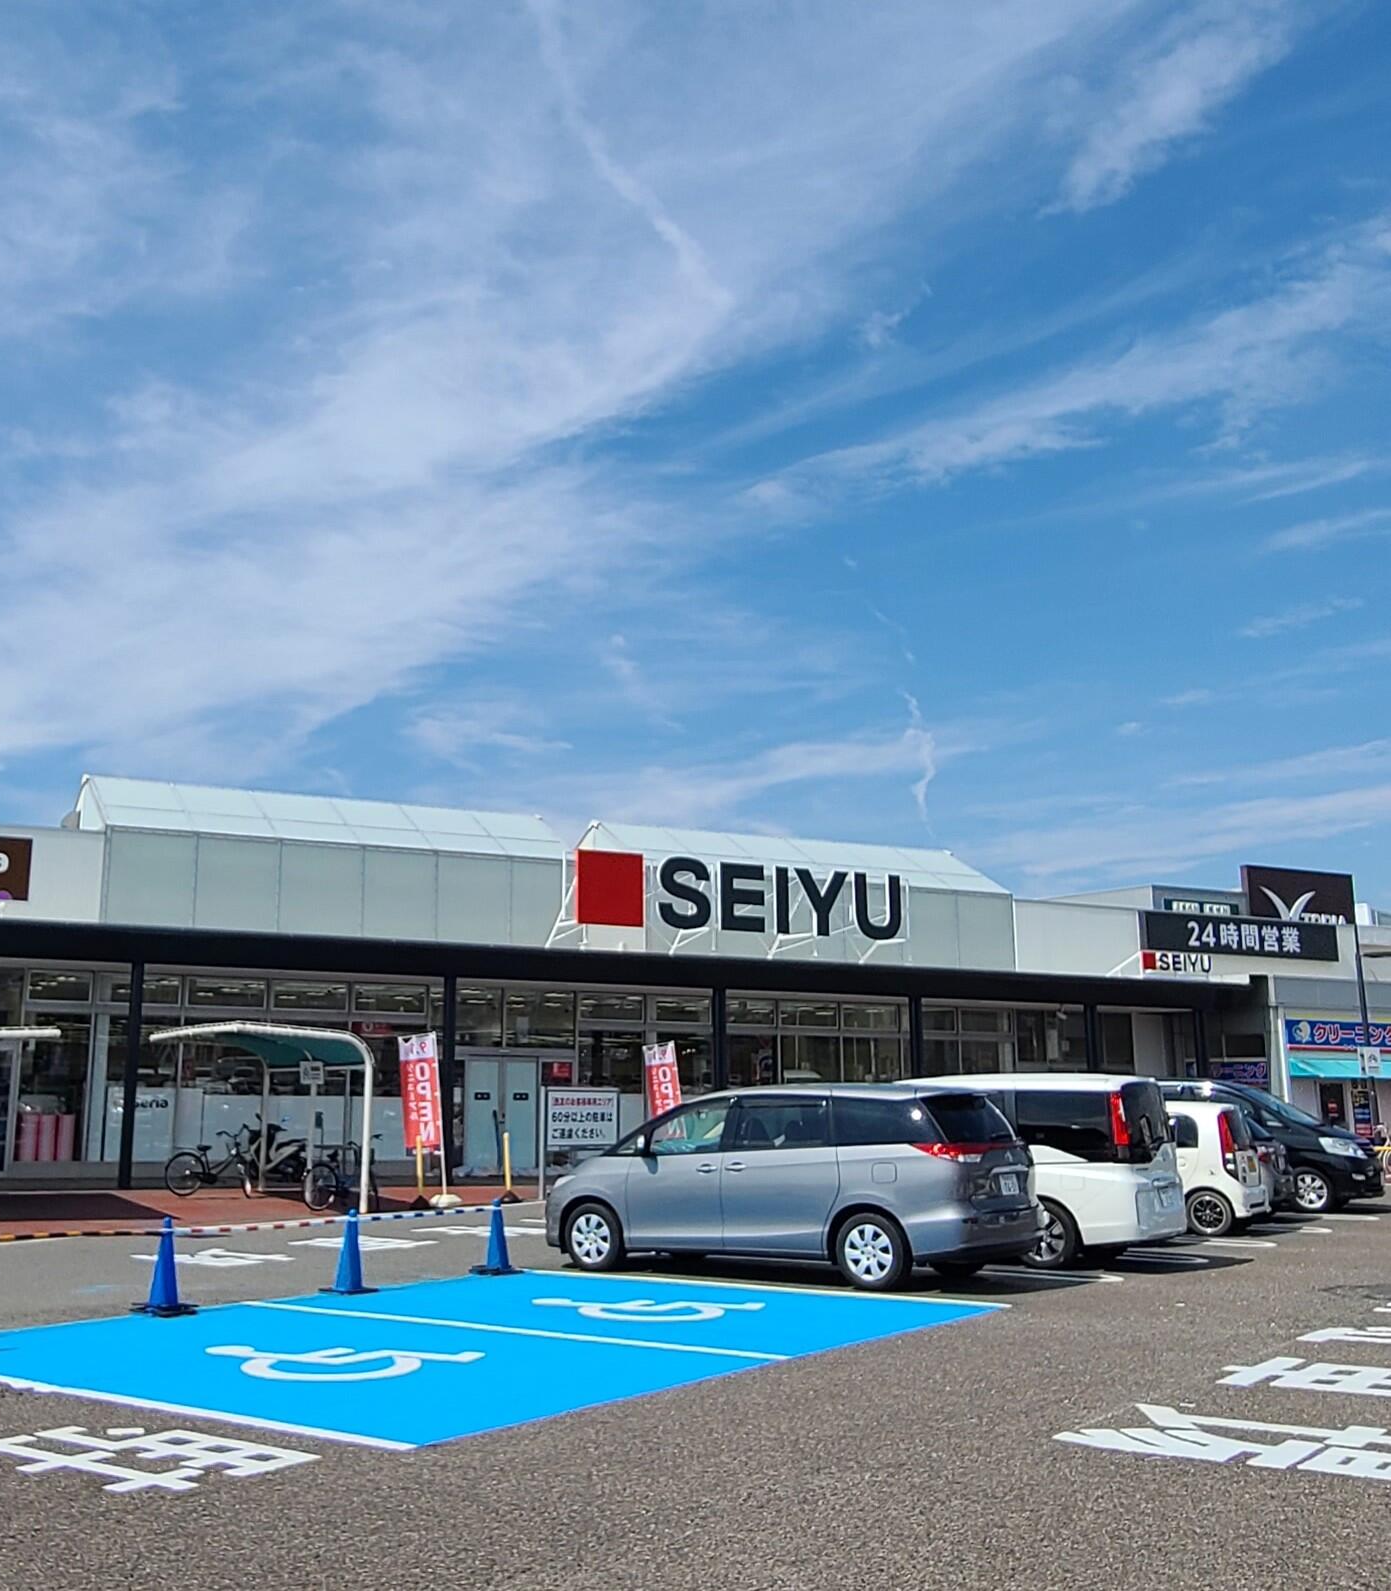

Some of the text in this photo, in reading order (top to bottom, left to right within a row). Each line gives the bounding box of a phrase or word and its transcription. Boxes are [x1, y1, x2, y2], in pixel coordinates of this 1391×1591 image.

[657, 855, 902, 941] SEIYU
[1186, 920, 1302, 953] 24時間営業
[1159, 953, 1212, 973] SEIYU
